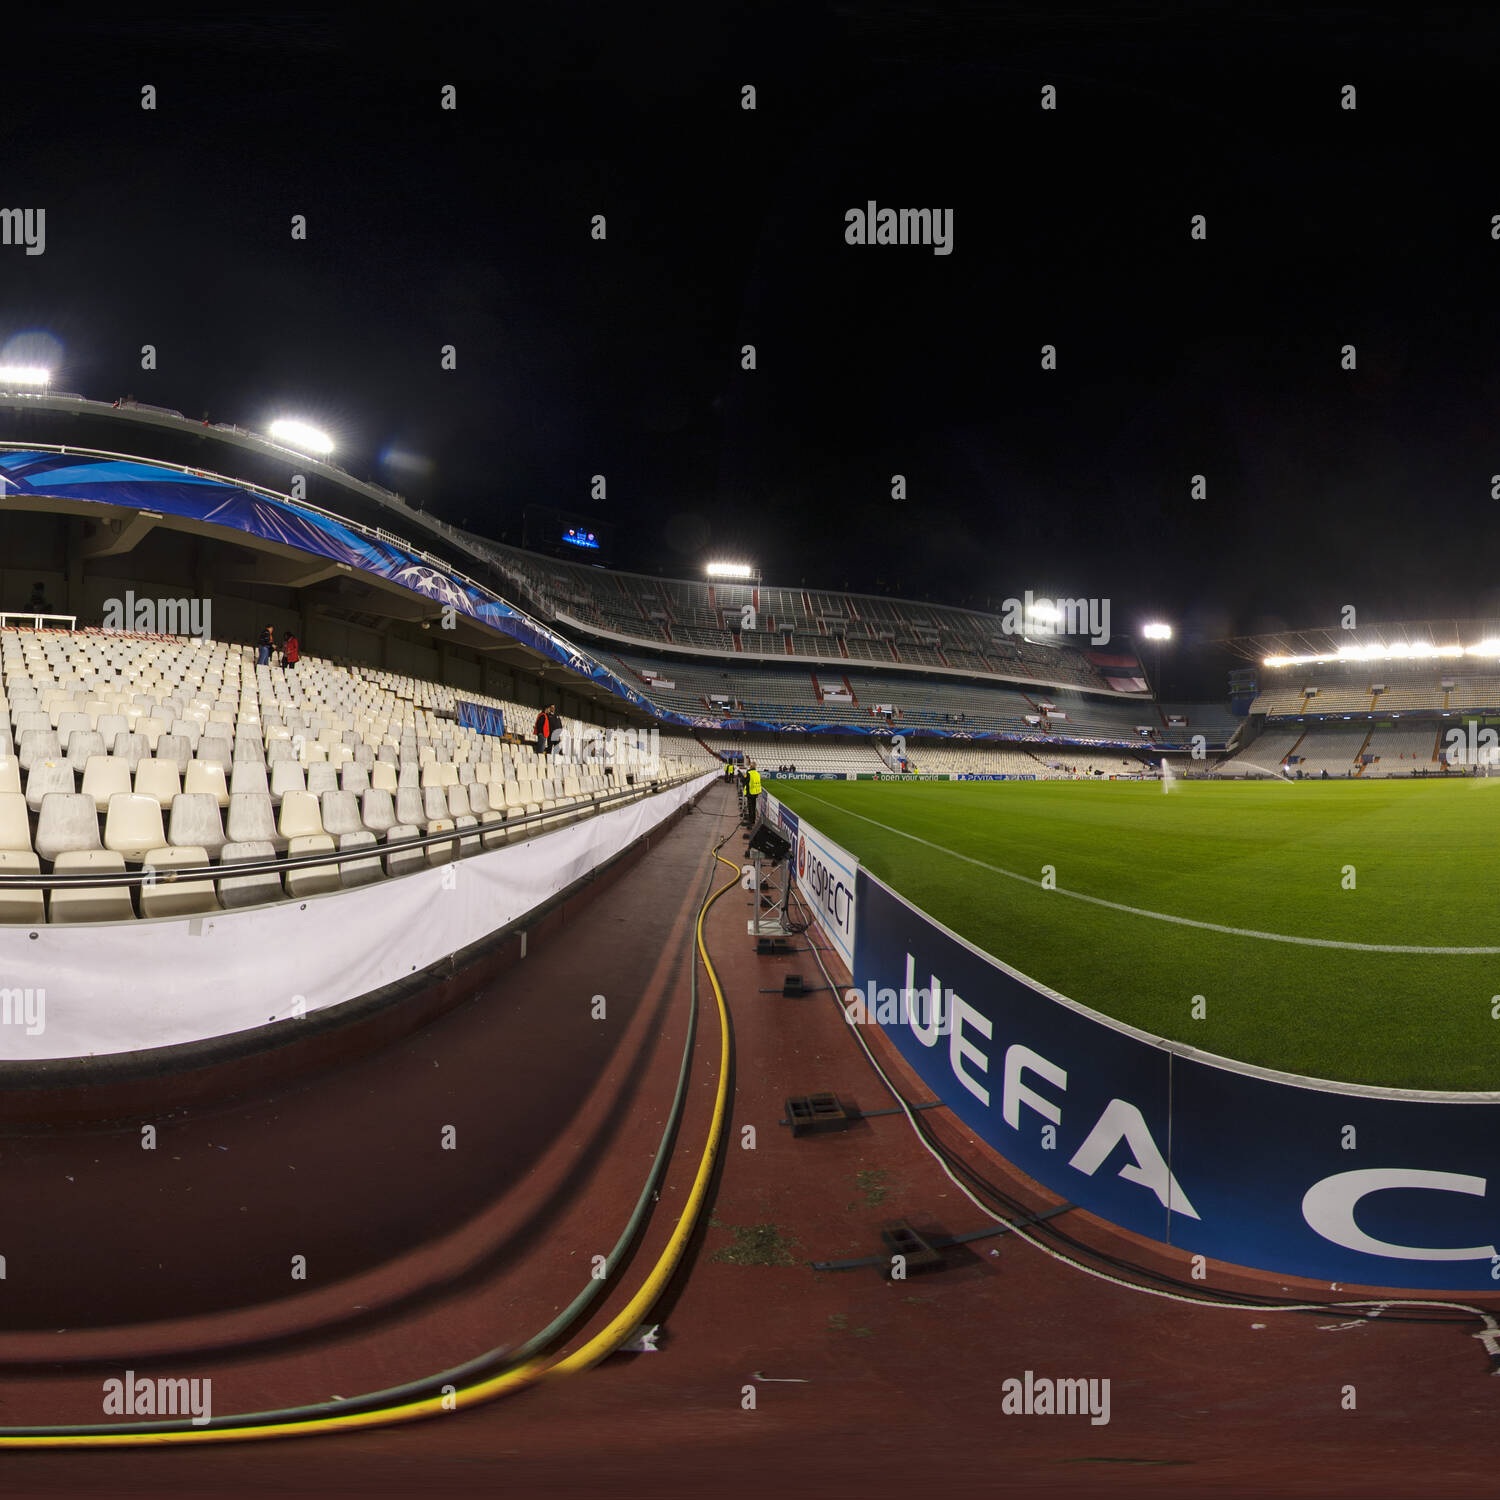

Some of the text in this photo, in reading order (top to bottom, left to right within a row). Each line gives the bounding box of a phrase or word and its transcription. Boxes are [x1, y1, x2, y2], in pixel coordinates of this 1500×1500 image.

[776, 772, 787, 780] Go
[788, 772, 816, 780] Further
[881, 773, 939, 783] open your world
[806, 850, 853, 935] RESPECT
[904, 952, 1202, 1221] UEFA
